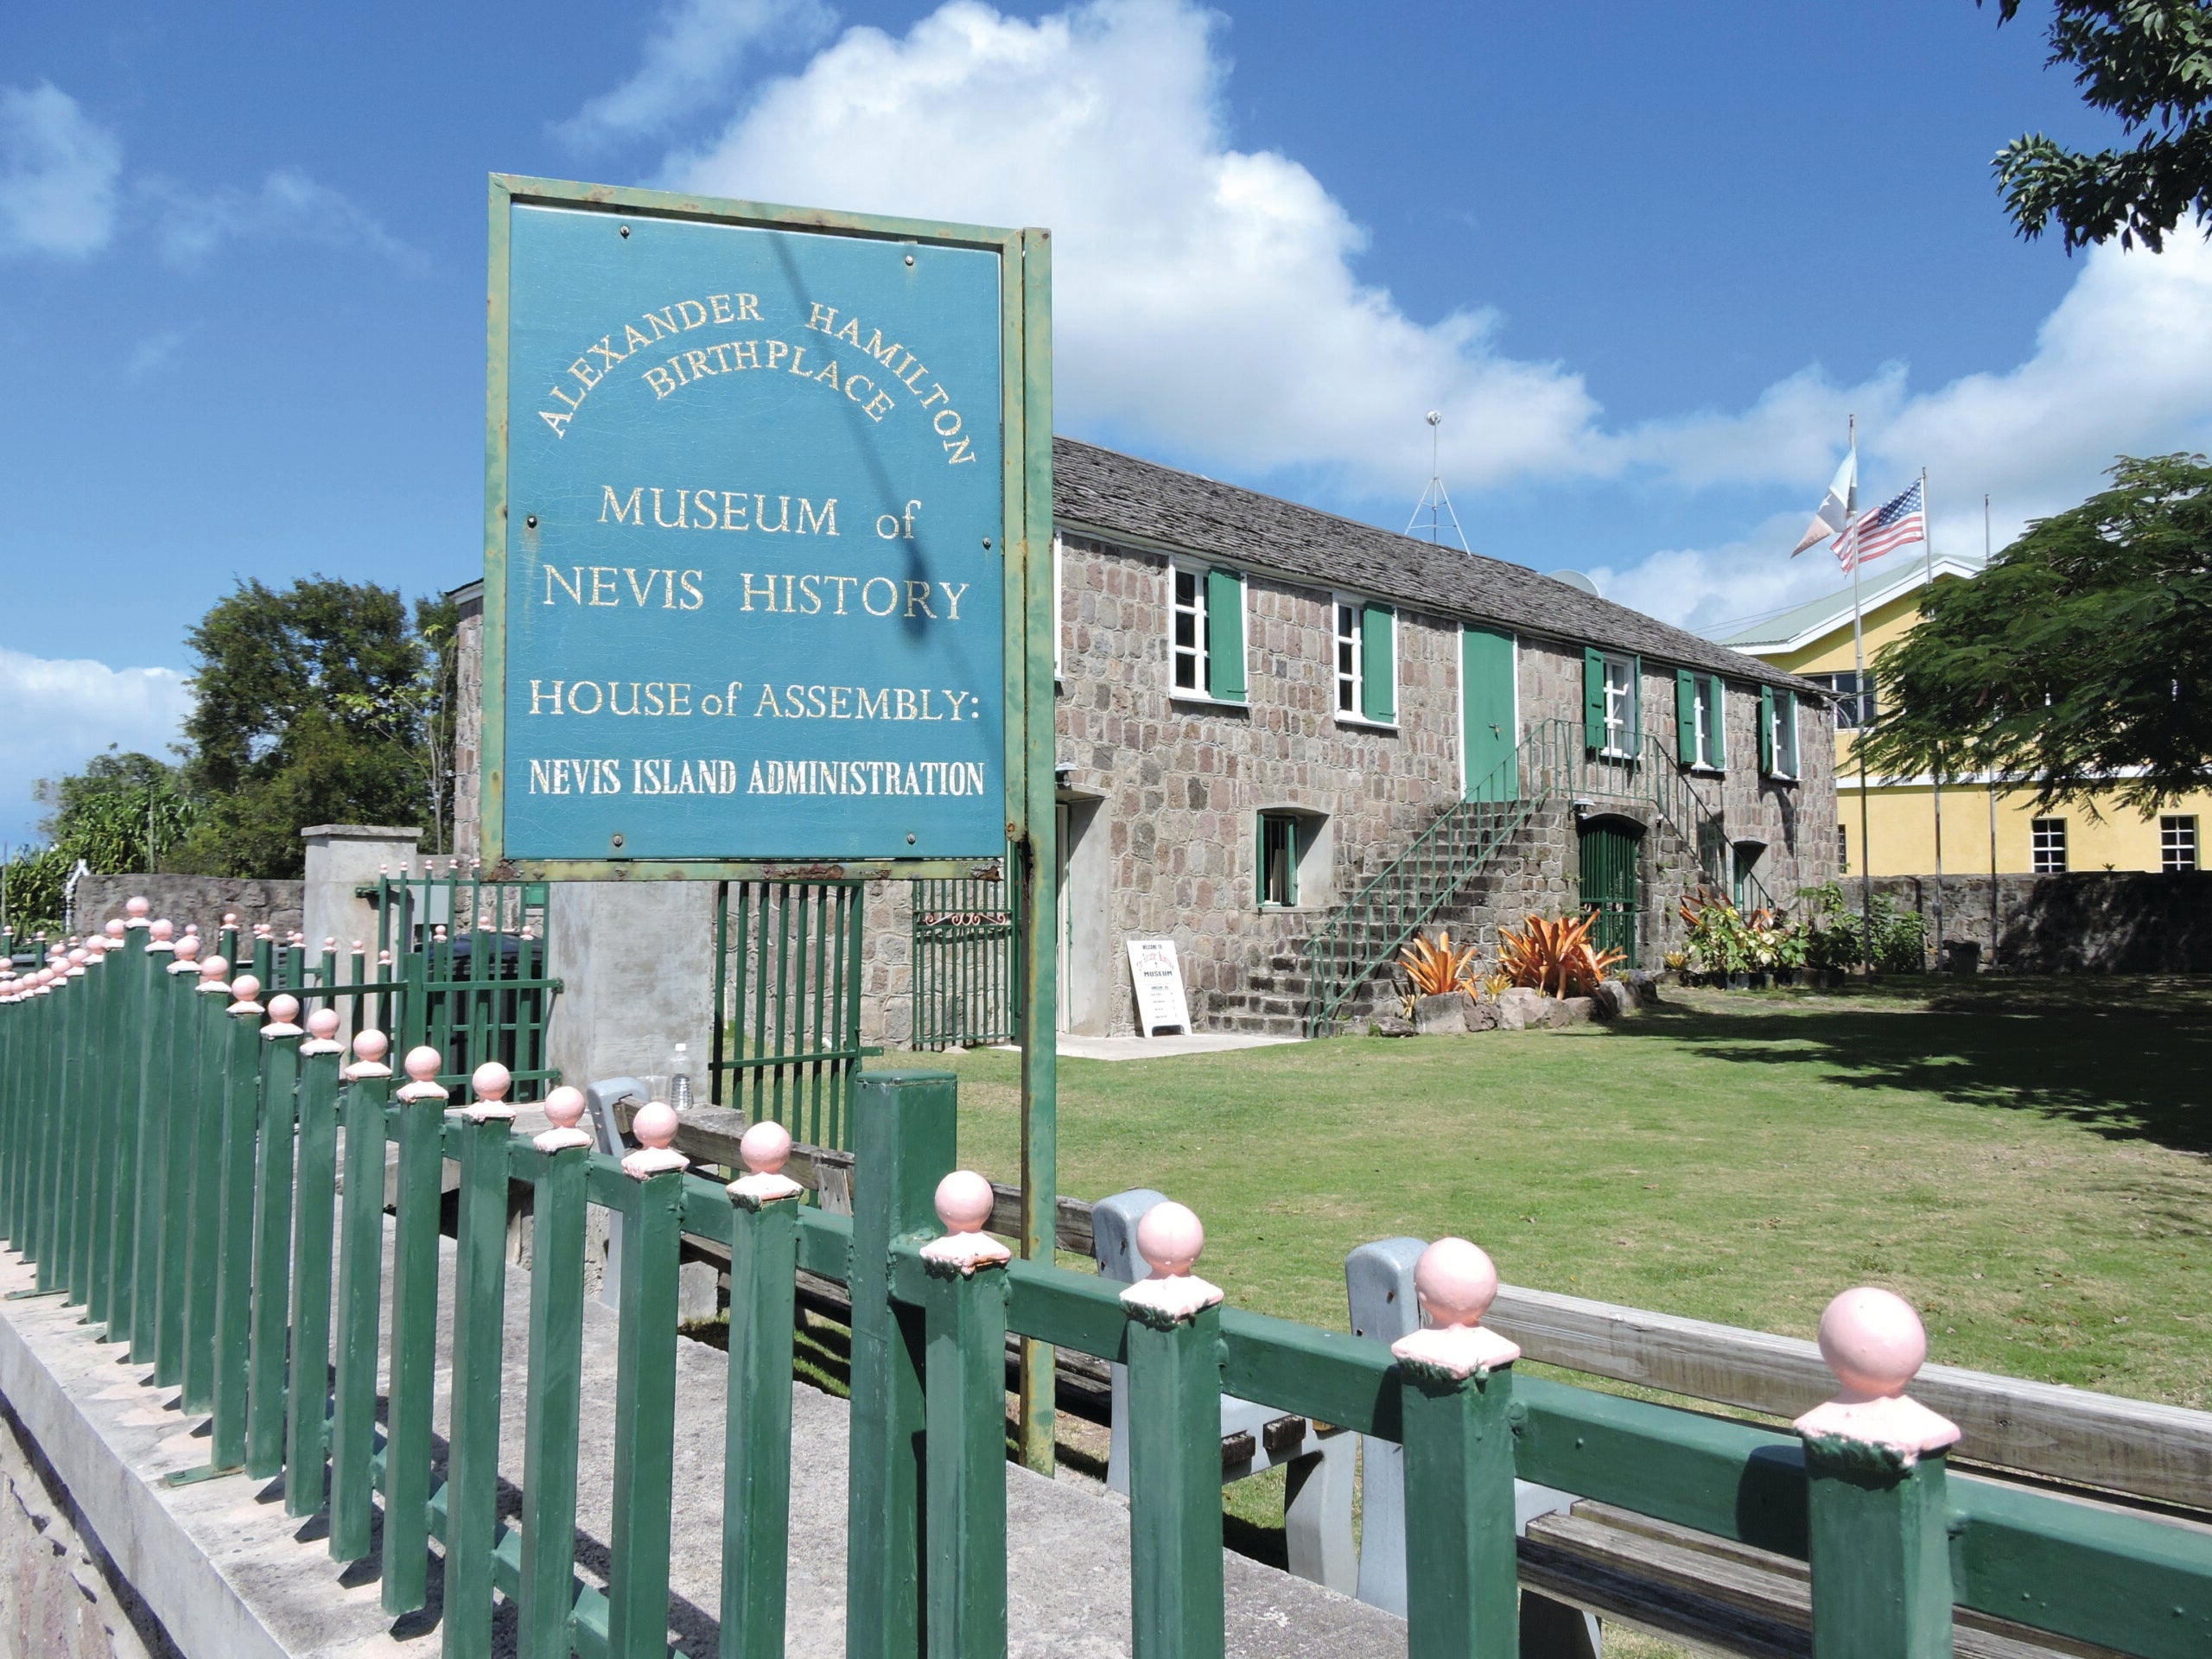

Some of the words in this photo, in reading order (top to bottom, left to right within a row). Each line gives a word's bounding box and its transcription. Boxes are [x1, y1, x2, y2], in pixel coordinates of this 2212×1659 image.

[538, 292, 765, 440] ALEXANDER
[804, 302, 976, 465] HAMILTON
[641, 339, 896, 423] BIRTHPLACE
[597, 485, 841, 537] MUSEUM
[875, 498, 922, 540] of
[543, 564, 704, 611] NEVIS
[740, 572, 970, 620] HISTORY
[529, 679, 692, 716] HOUSE
[701, 681, 743, 716] of
[753, 683, 981, 721] ASSEMBLY:
[528, 759, 621, 795] NEVIS
[632, 759, 737, 796] ISLAND
[746, 760, 985, 796] ADMINISTRATION
